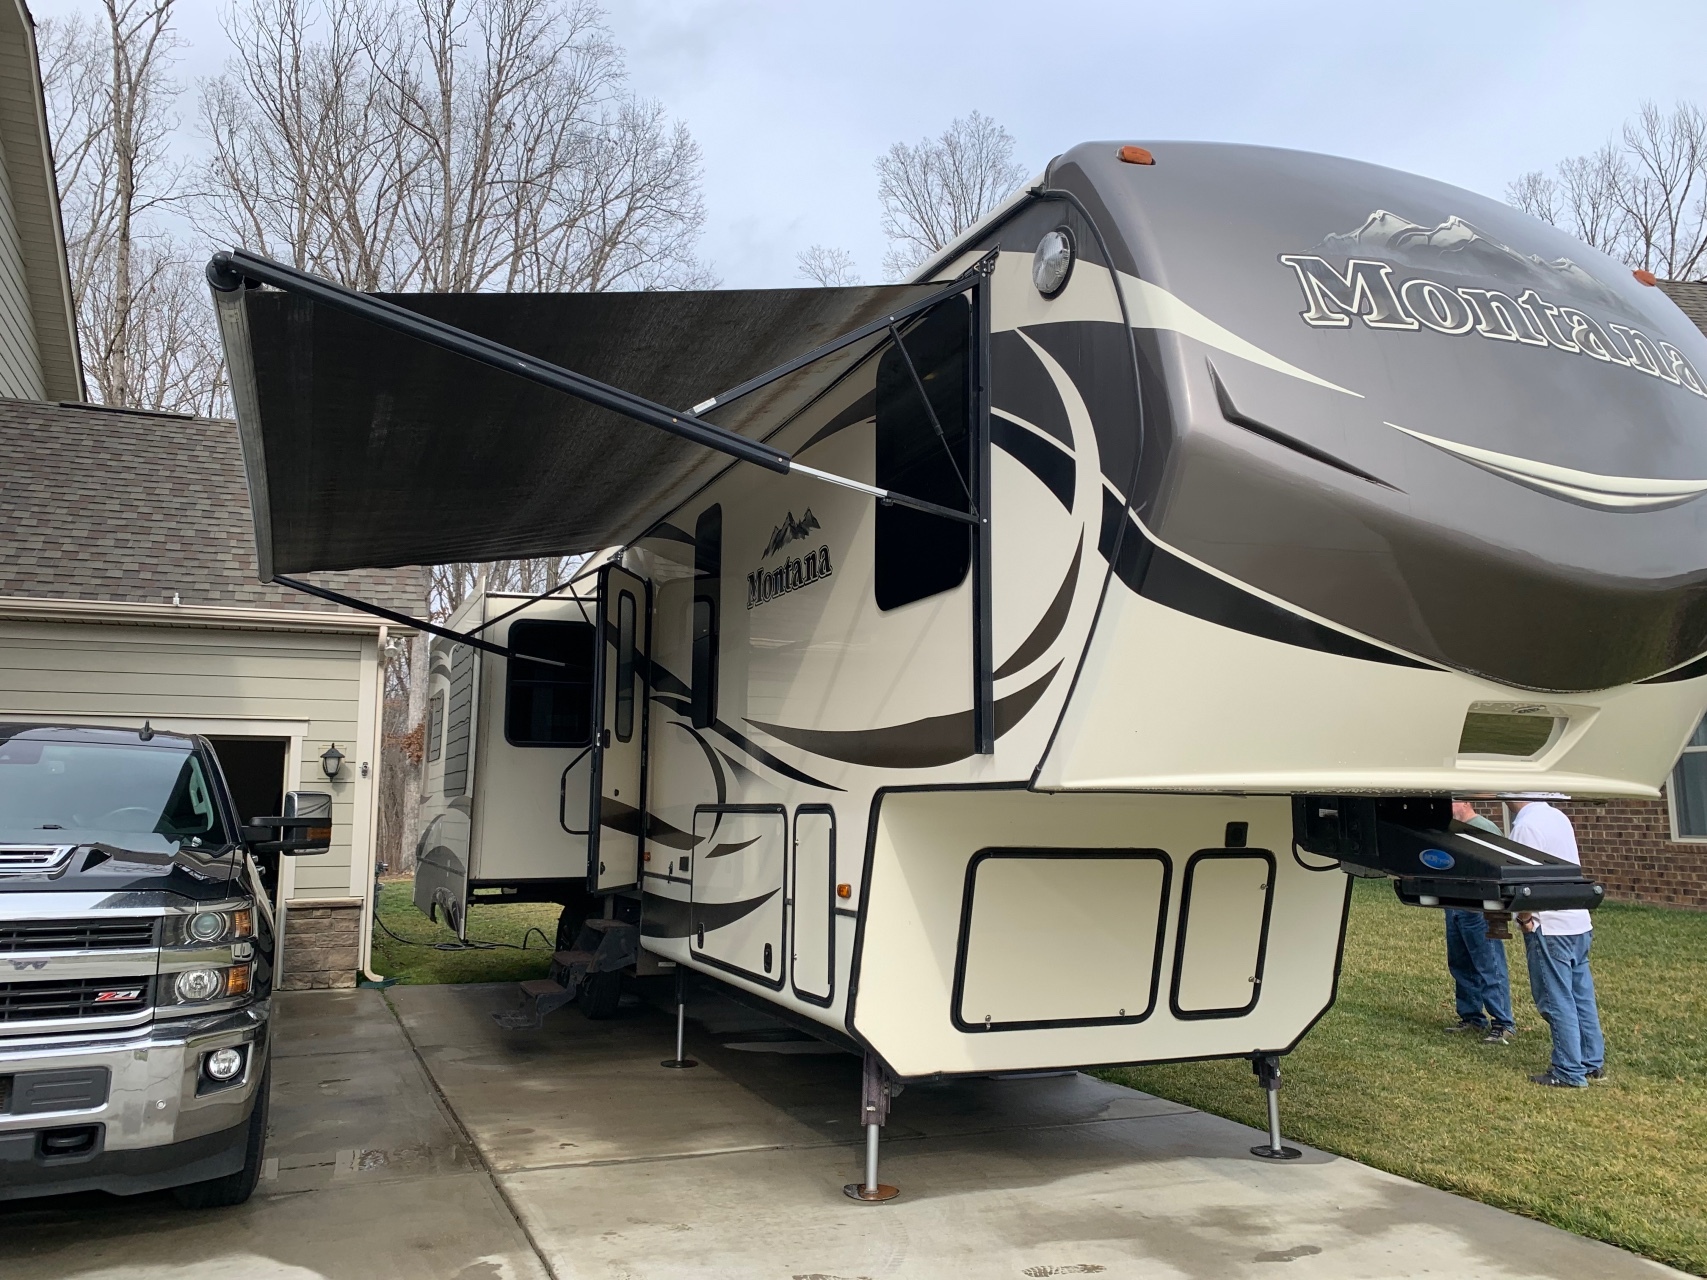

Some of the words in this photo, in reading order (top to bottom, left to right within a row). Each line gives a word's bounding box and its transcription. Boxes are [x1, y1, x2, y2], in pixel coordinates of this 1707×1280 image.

[1279, 254, 1707, 398] Montana
[747, 545, 833, 610] Montana
[95, 990, 141, 1001] Z71
